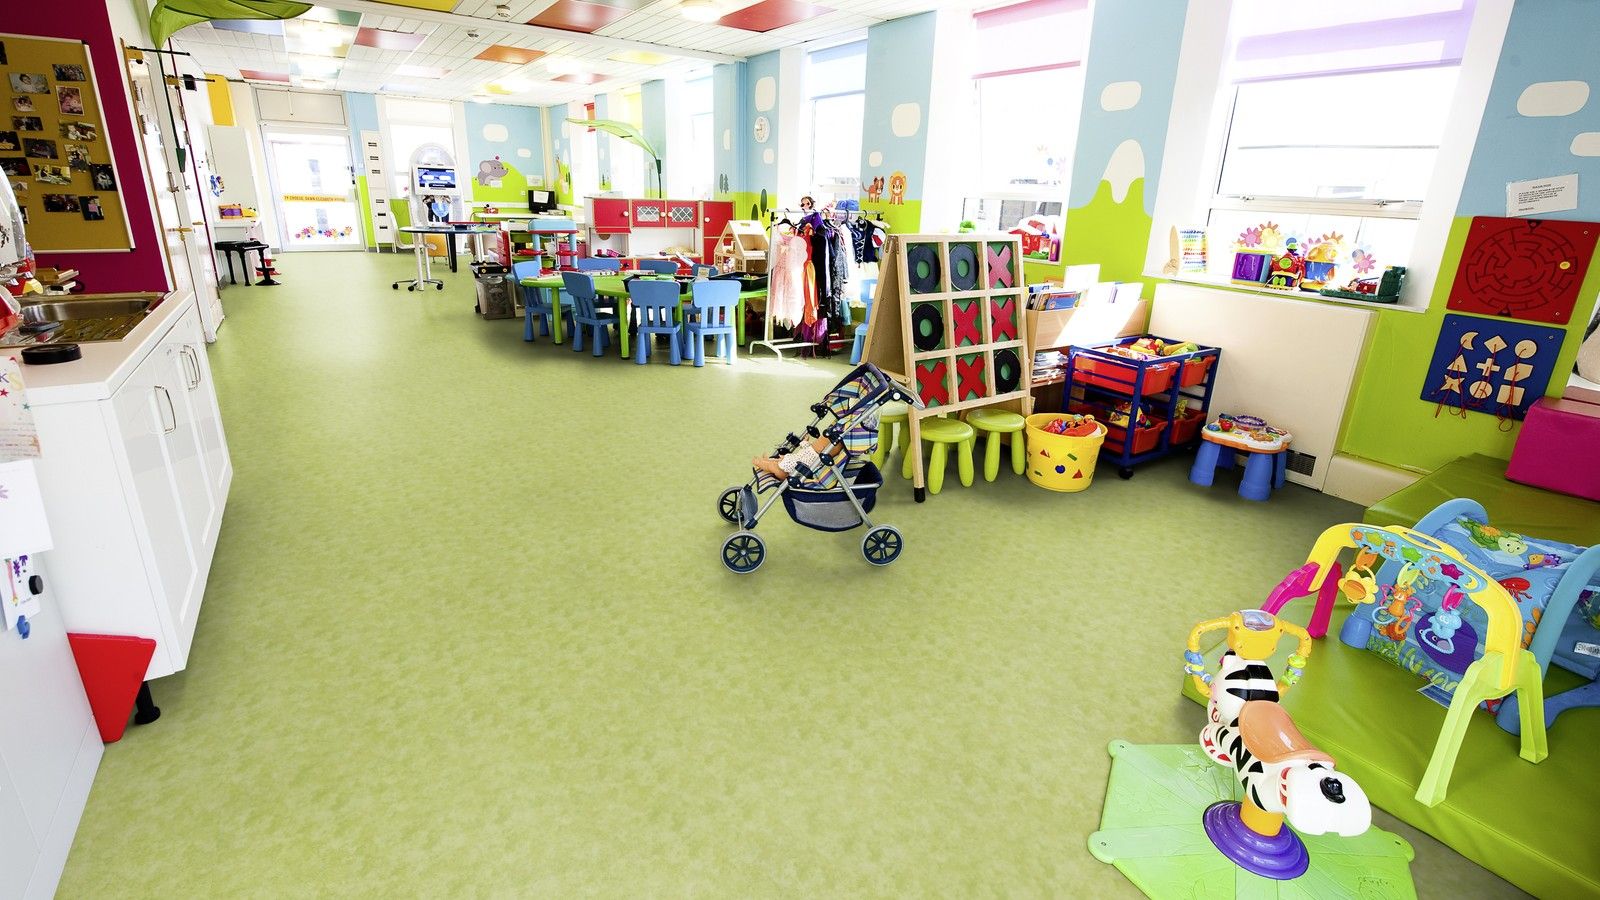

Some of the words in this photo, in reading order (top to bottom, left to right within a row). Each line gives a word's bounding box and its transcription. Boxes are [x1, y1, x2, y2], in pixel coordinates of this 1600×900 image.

[988, 245, 1013, 289] X
[953, 301, 981, 348] X
[991, 298, 1018, 343] X
[916, 361, 949, 408] X
[957, 355, 987, 401] X
